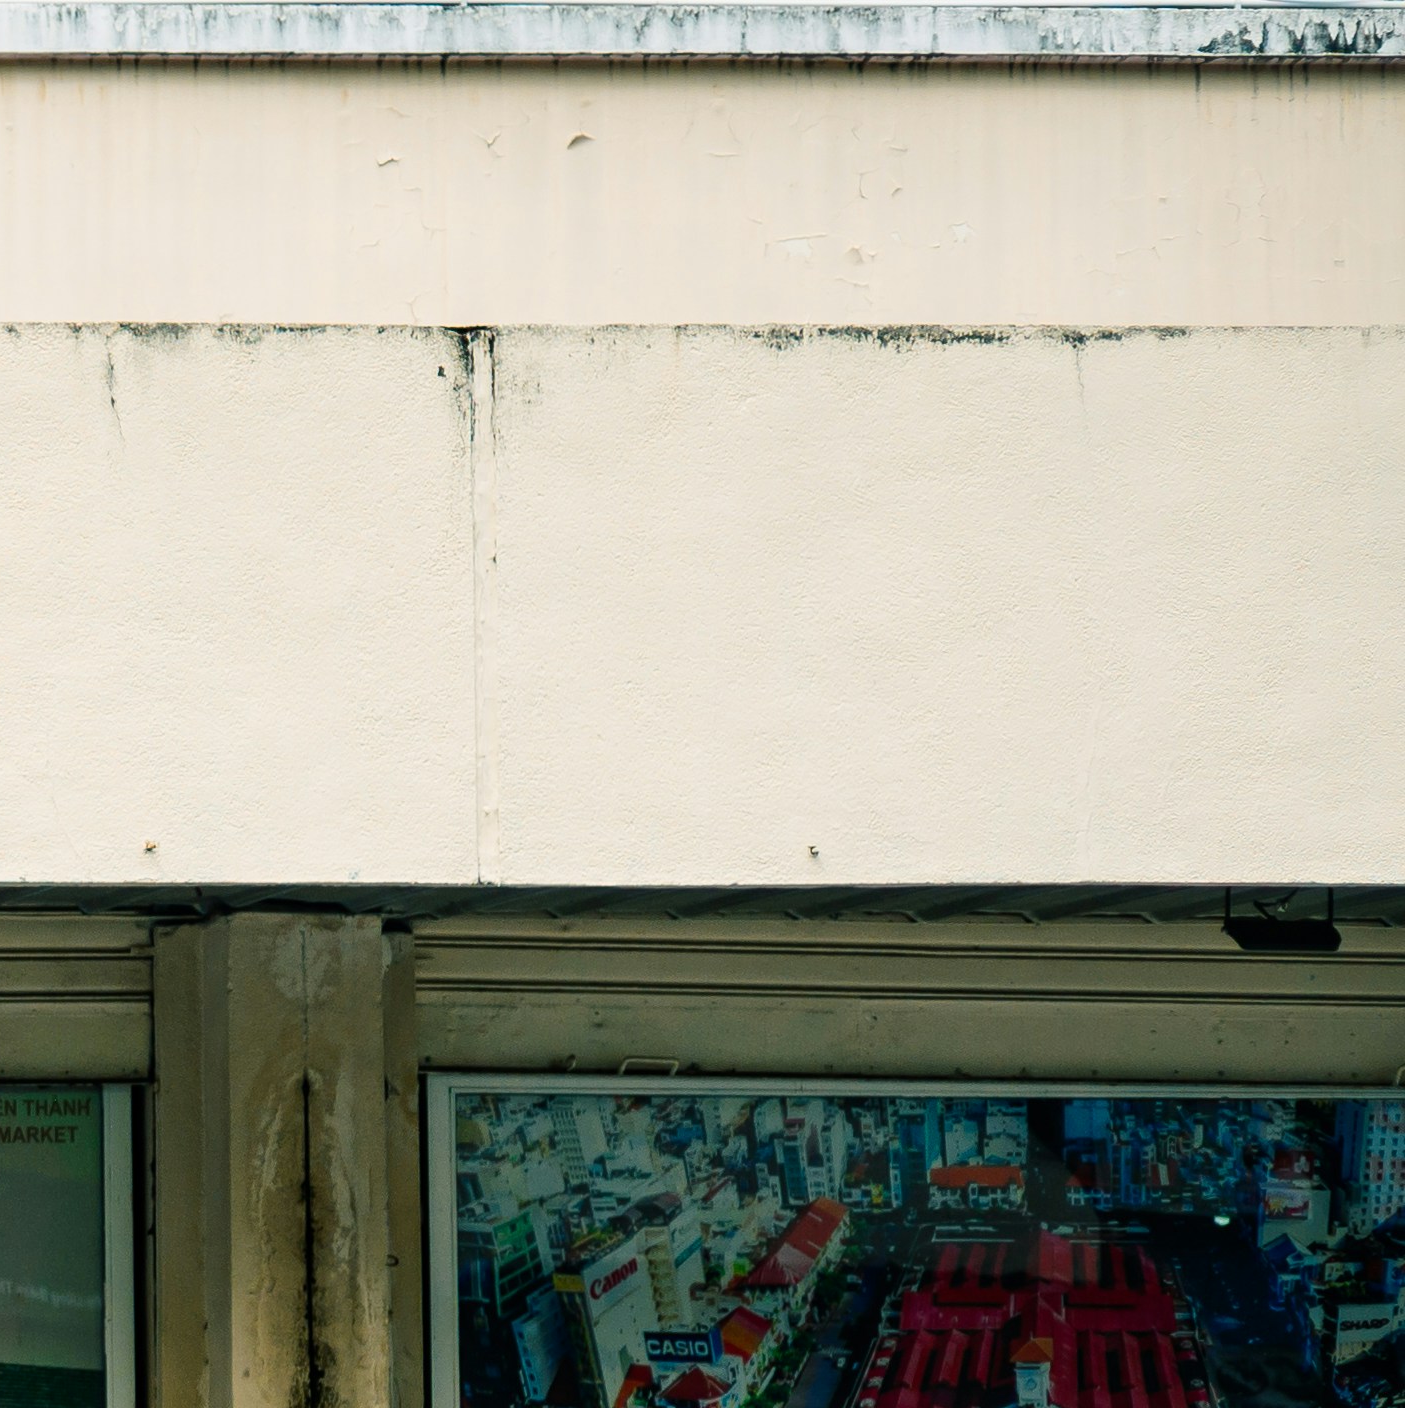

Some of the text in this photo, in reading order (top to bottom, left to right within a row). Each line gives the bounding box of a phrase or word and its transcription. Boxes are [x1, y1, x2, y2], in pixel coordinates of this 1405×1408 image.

[590, 1258, 638, 1300] Canon
[1340, 1318, 1390, 1331] SHARP
[646, 1339, 710, 1357] CASIO
